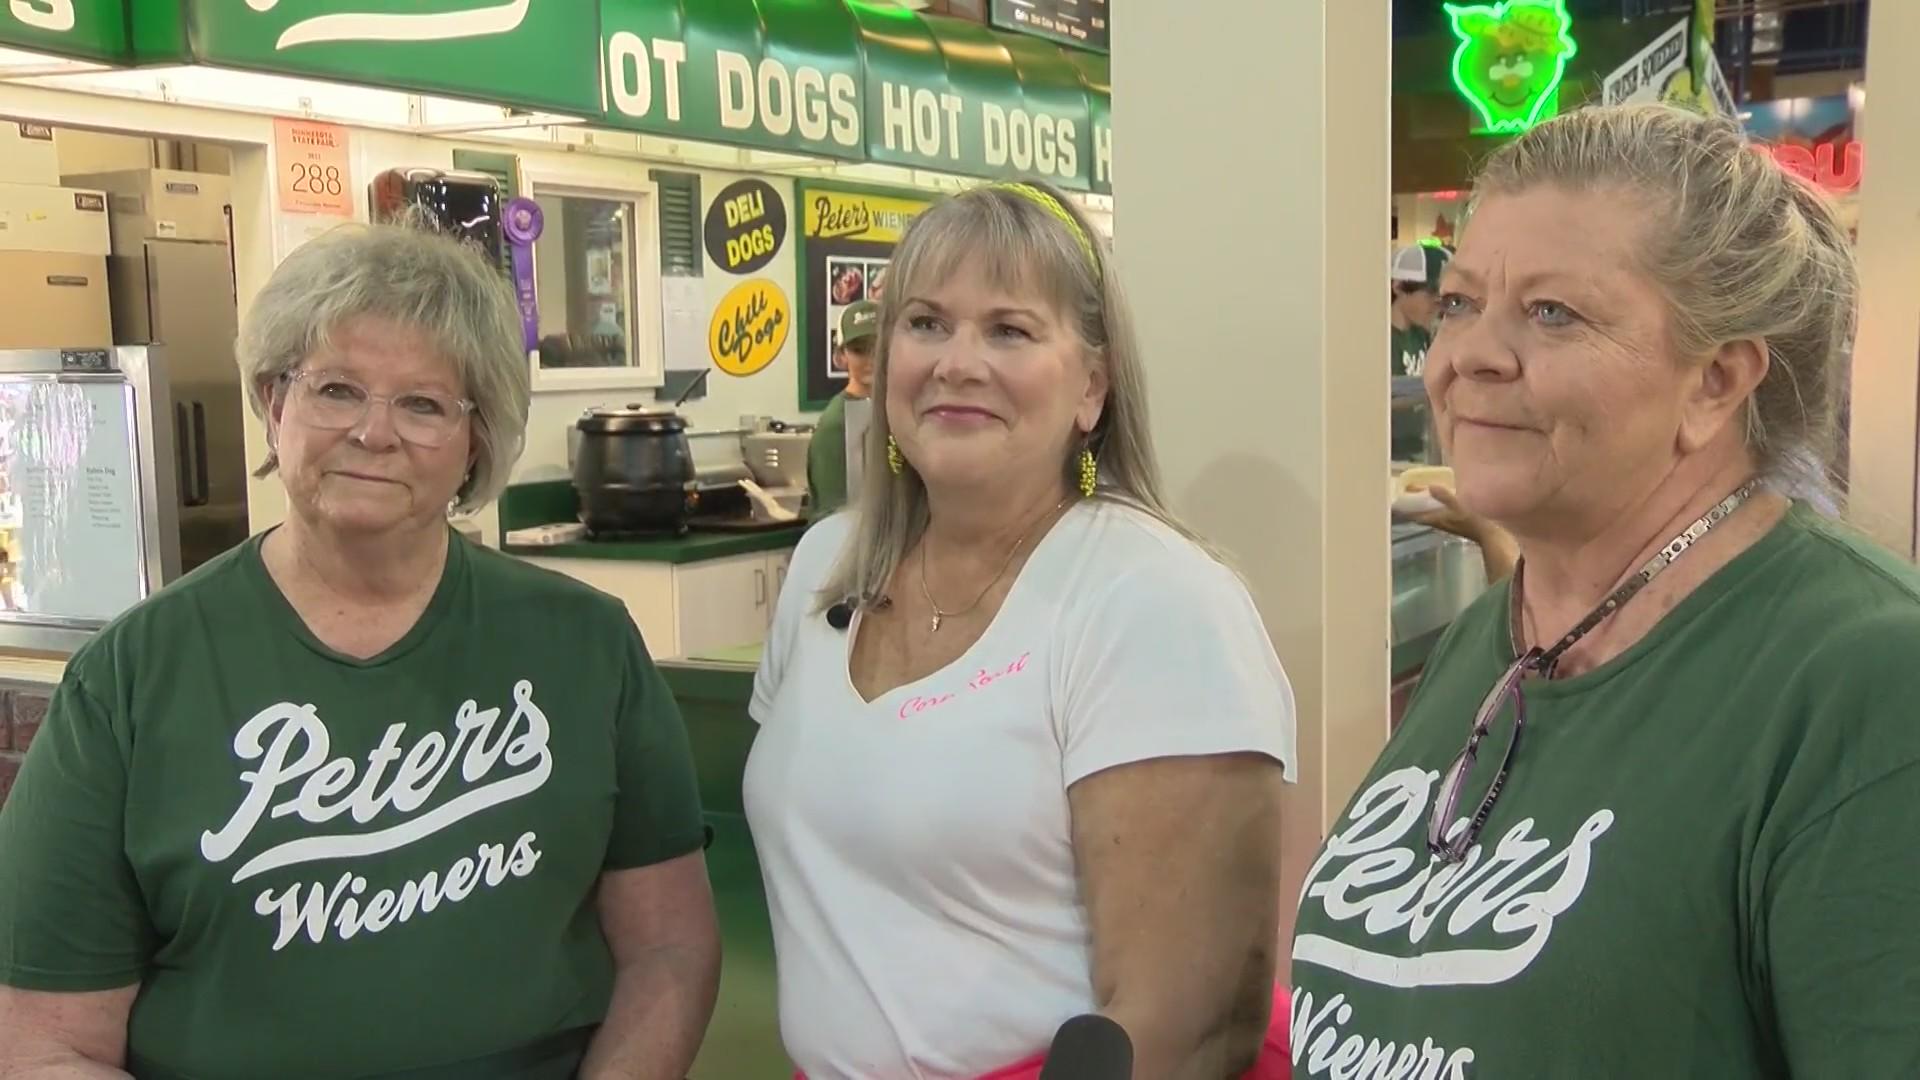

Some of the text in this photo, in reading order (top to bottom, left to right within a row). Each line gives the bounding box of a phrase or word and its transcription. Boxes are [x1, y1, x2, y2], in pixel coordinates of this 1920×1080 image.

[601, 31, 860, 147] OT DOGS
[882, 81, 1078, 178] HOT DOGS
[291, 162, 342, 196] 288
[724, 189, 765, 229] DELI
[726, 224, 775, 267] DOGS
[718, 289, 769, 357] Chili
[732, 306, 784, 363] Dogs
[200, 680, 552, 866] Peters
[255, 831, 542, 951] Wieners
